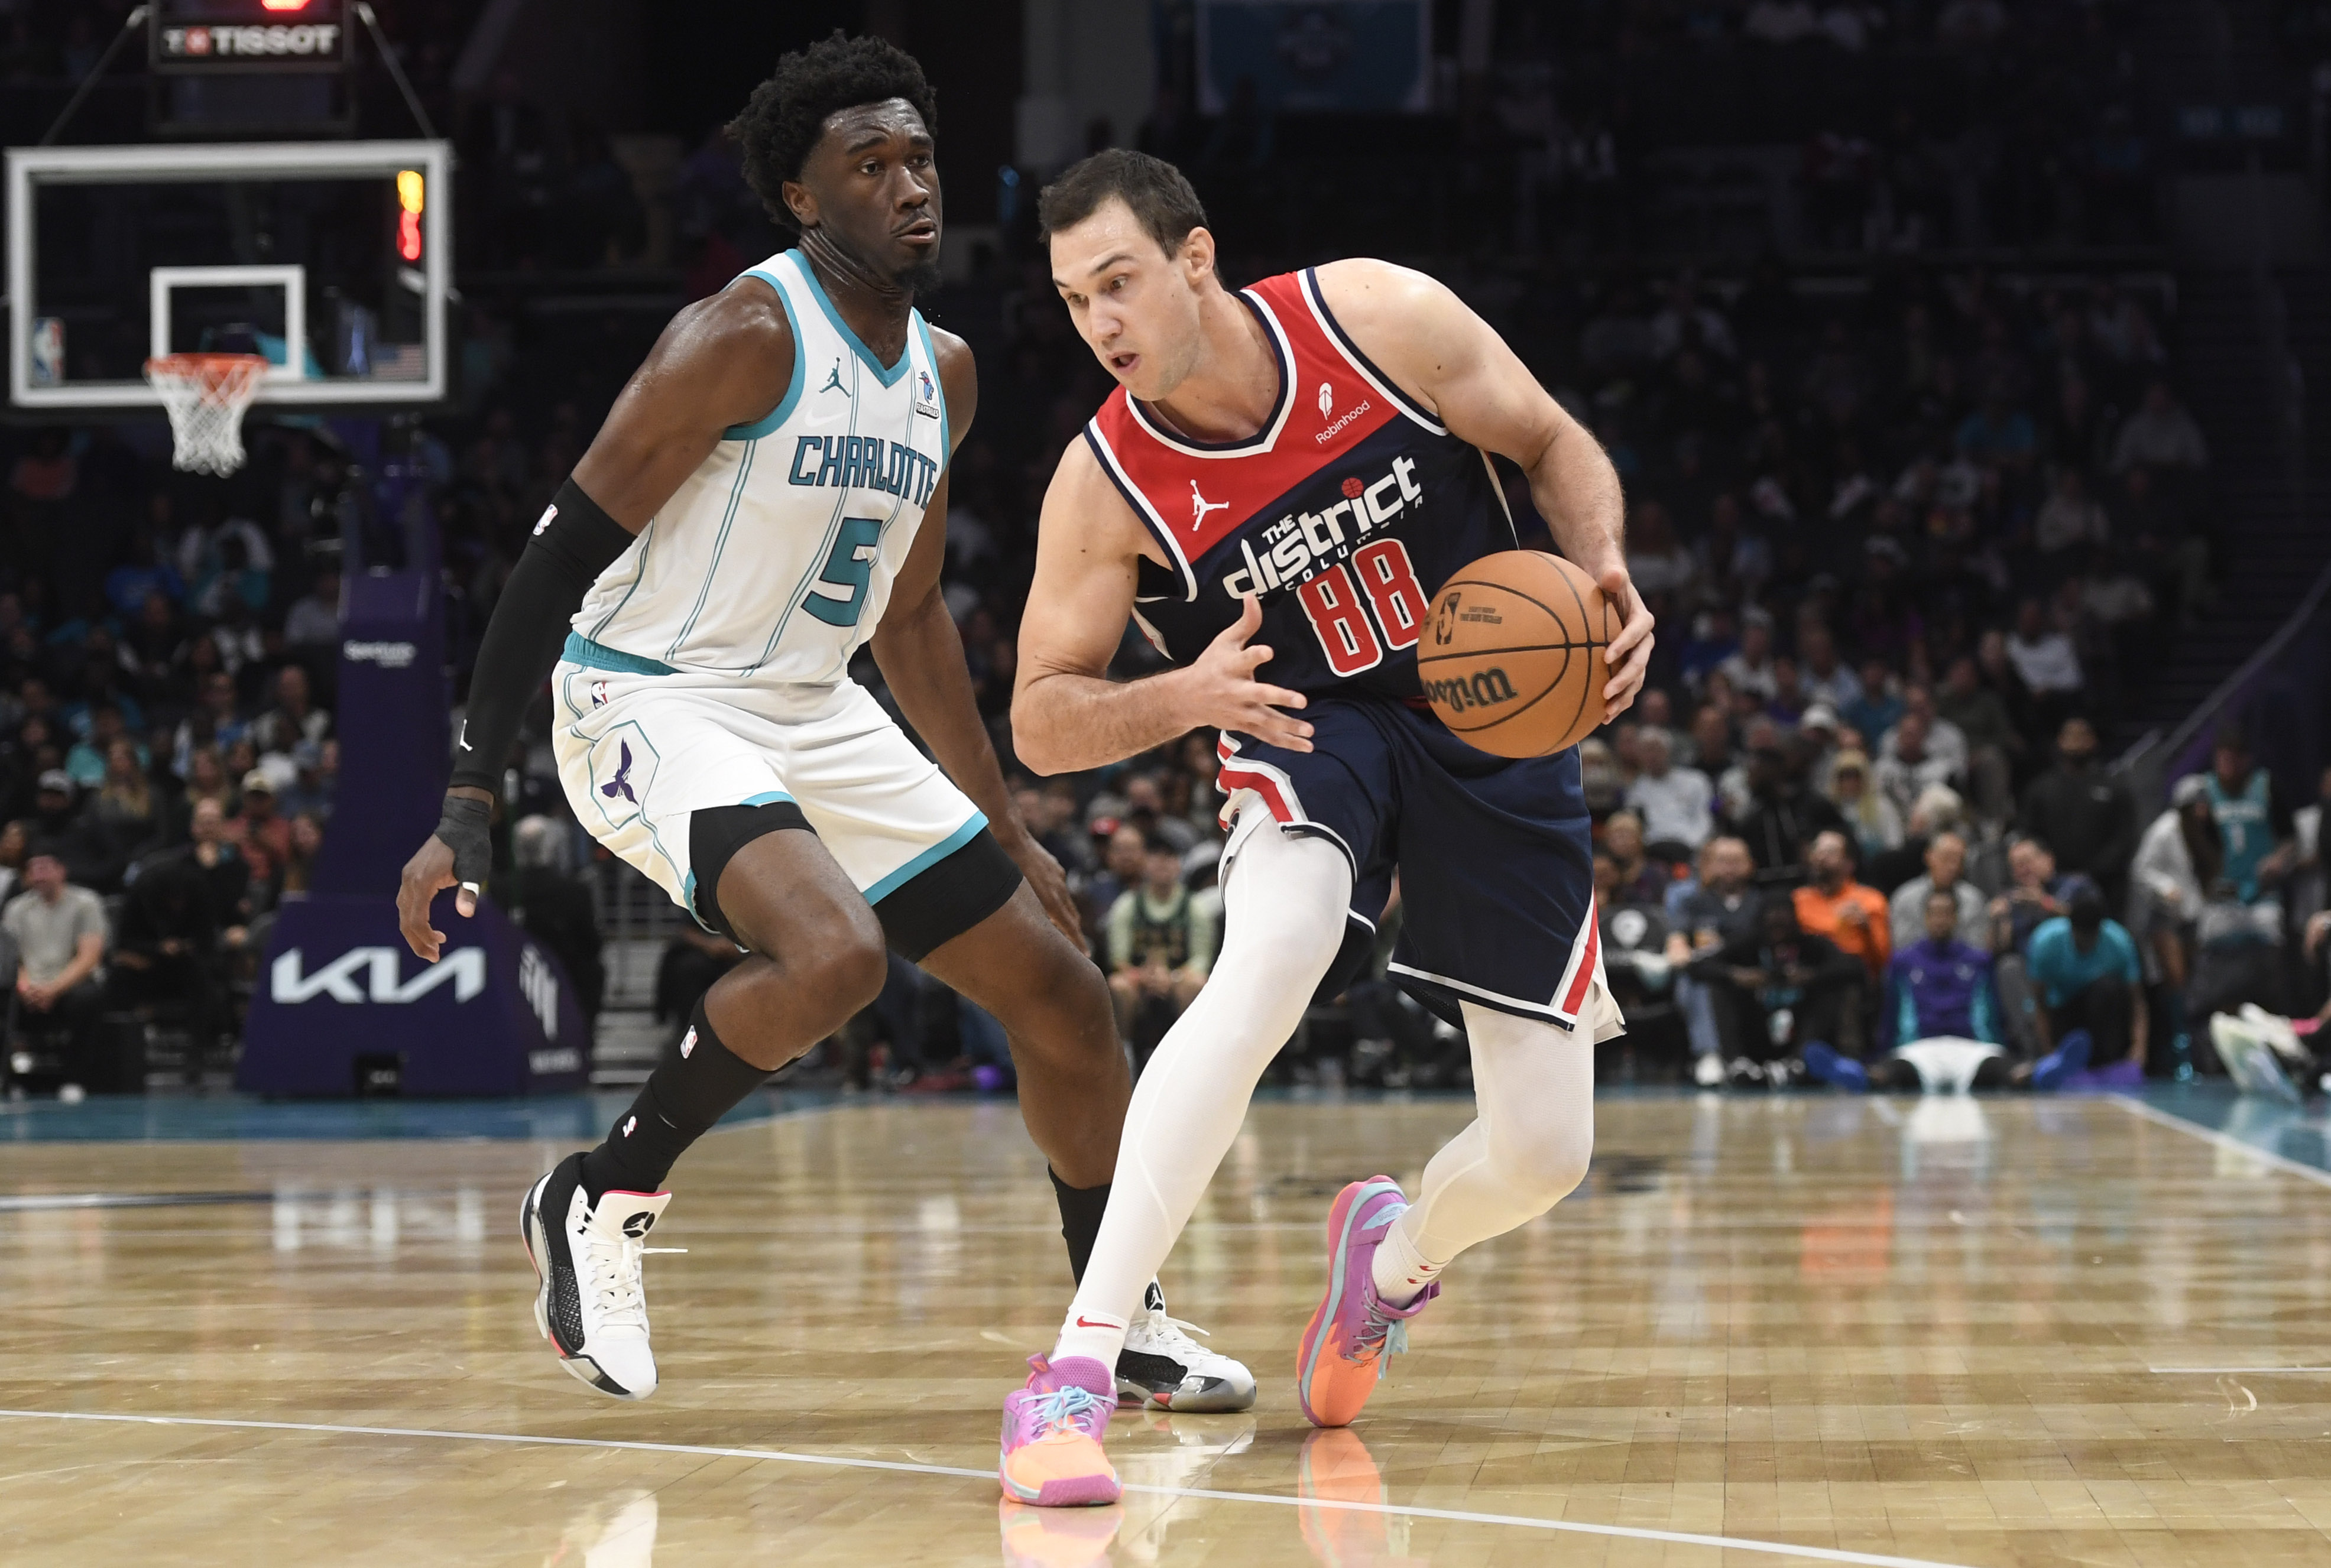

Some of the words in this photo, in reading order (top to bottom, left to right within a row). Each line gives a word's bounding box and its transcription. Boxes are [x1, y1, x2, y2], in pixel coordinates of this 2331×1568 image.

[211, 25, 339, 54] TISSOT
[1315, 400, 1370, 444] Robinhood
[789, 436, 937, 510] CHARLOTTE
[1223, 456, 1421, 599] district
[1262, 514, 1296, 544] THE
[801, 517, 883, 627] 5
[1296, 538, 1429, 677] 88
[271, 946, 487, 1004] KIA
